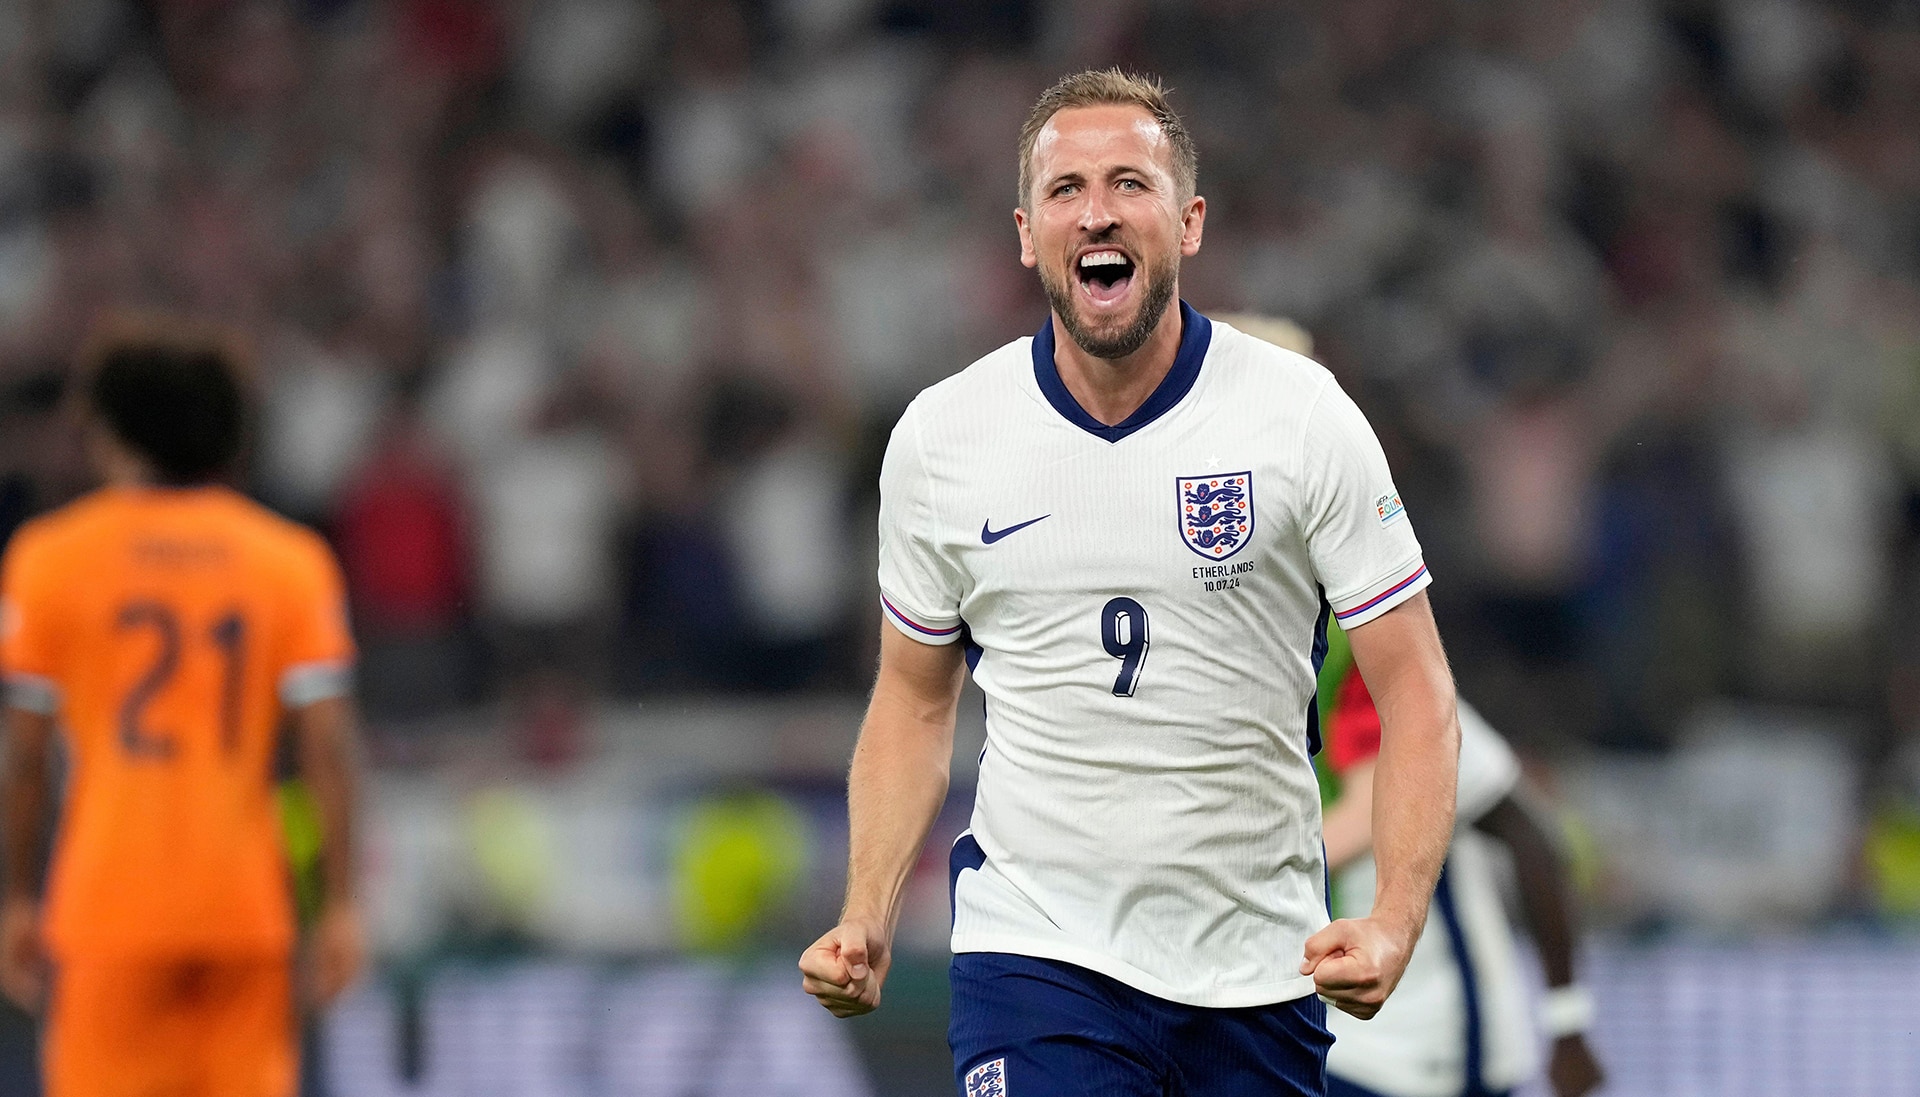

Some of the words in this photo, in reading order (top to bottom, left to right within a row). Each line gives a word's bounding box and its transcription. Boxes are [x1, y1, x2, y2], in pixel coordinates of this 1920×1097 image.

[1192, 561, 1254, 579] ETHERLANDS
[1204, 578, 1240, 592] 10.07.24
[1101, 597, 1150, 697] 9
[112, 600, 245, 764] 21
